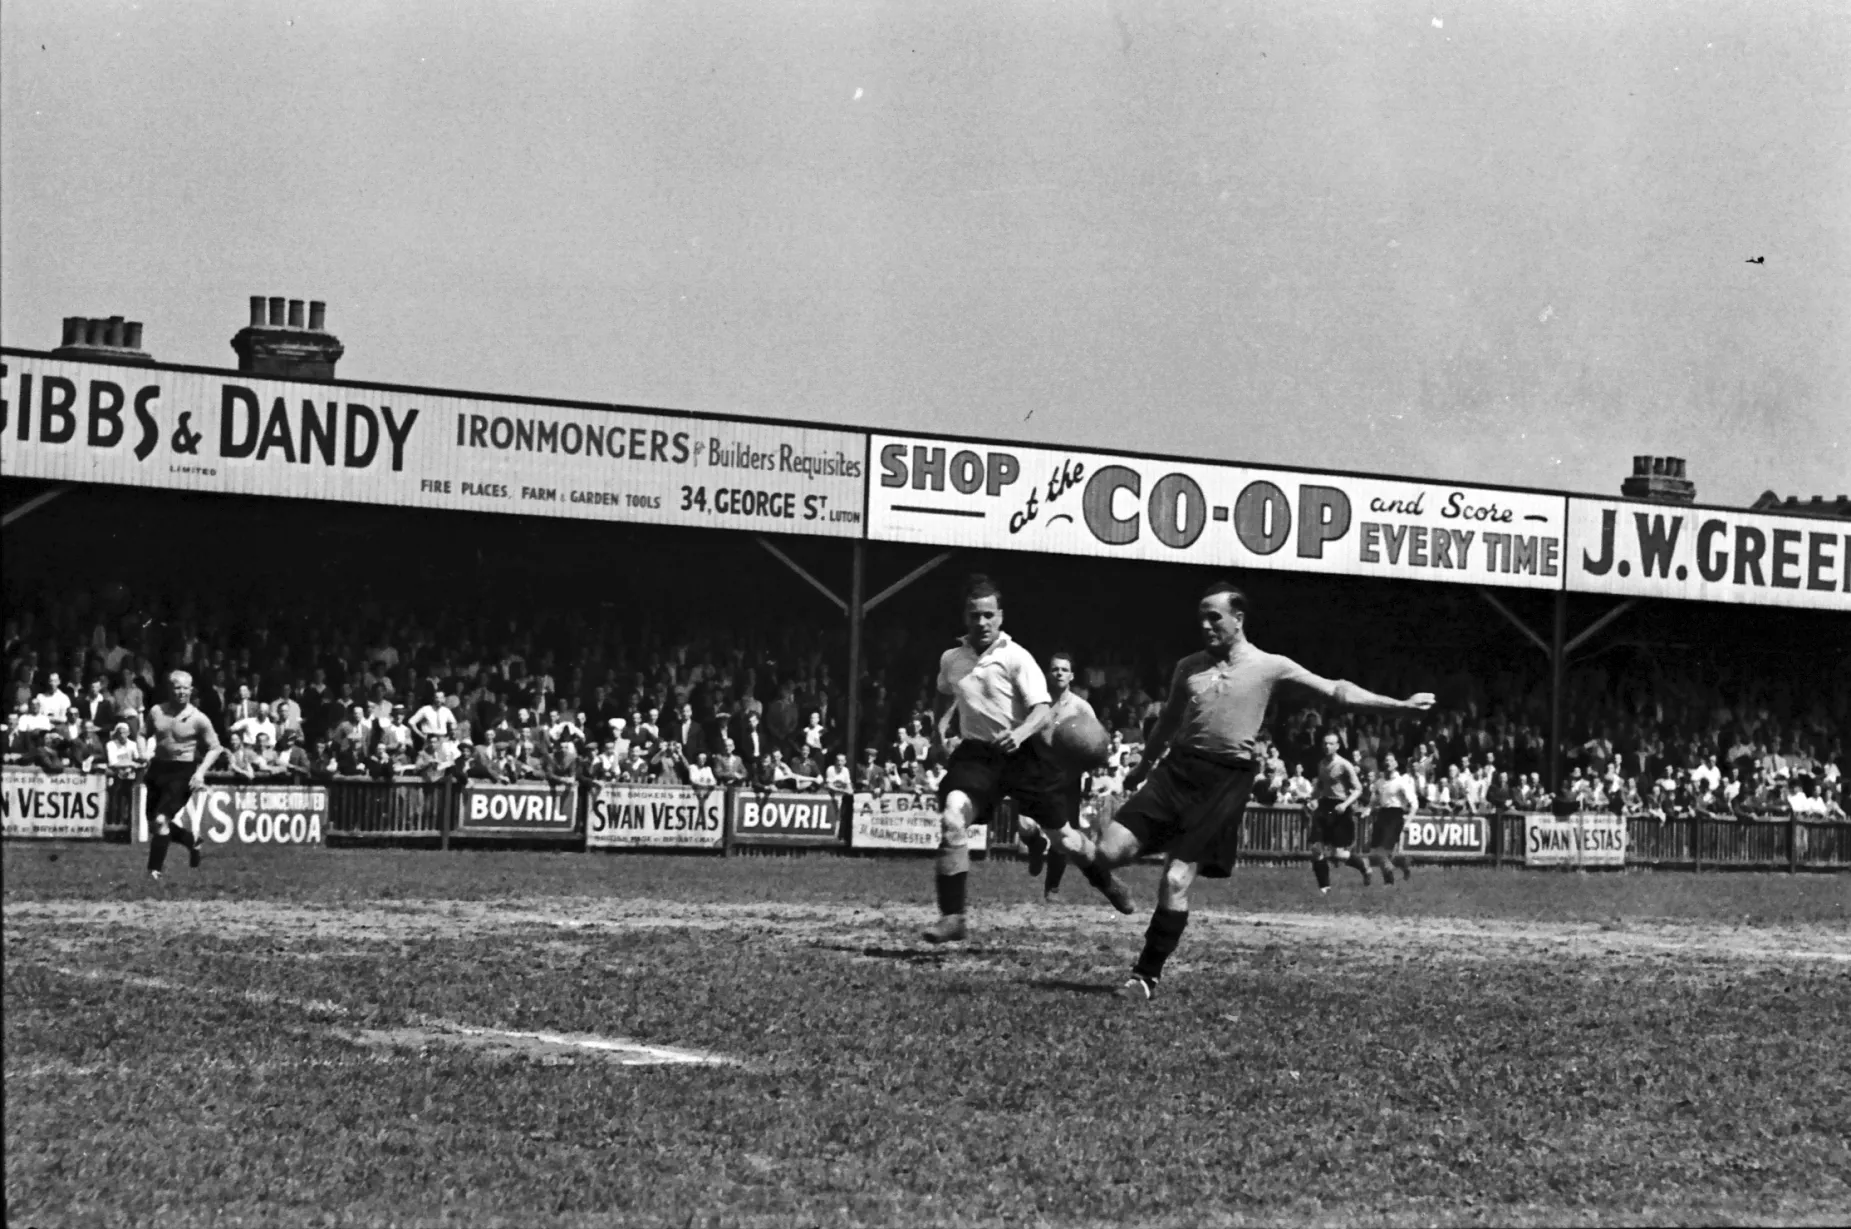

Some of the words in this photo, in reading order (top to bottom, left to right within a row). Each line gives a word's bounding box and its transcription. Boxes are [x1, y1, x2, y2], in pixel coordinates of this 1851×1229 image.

[171, 411, 203, 456] &
[220, 384, 420, 472] DANDY
[456, 414, 690, 464] IRONMONGERS
[708, 437, 775, 471] Builders
[779, 443, 861, 480] Requisites
[420, 479, 451, 494] FIRE
[521, 486, 557, 502] FARM
[570, 490, 619, 506] GARDEN
[626, 494, 661, 509] TOOLS
[714, 487, 796, 519] GEORGE
[829, 509, 861, 524] LUTON
[880, 443, 1020, 497] SHOP
[1009, 486, 1039, 534] at
[1045, 458, 1084, 503] the
[1082, 464, 1352, 559] CO-OP
[1369, 491, 1426, 516] and
[1440, 492, 1513, 523] Score
[1359, 521, 1475, 570] EVERY
[1482, 531, 1559, 577] TIME
[18, 788, 100, 819] VESTAS
[470, 794, 568, 822] BOVRIL
[592, 800, 645, 831] SWAN
[651, 802, 719, 831] VESTAS
[743, 802, 832, 830] BOVRIL
[238, 810, 321, 843] COCOA
[1408, 823, 1480, 847] BOVRIL
[1529, 826, 1569, 853] SWAN
[1573, 827, 1622, 851] VESTAS
